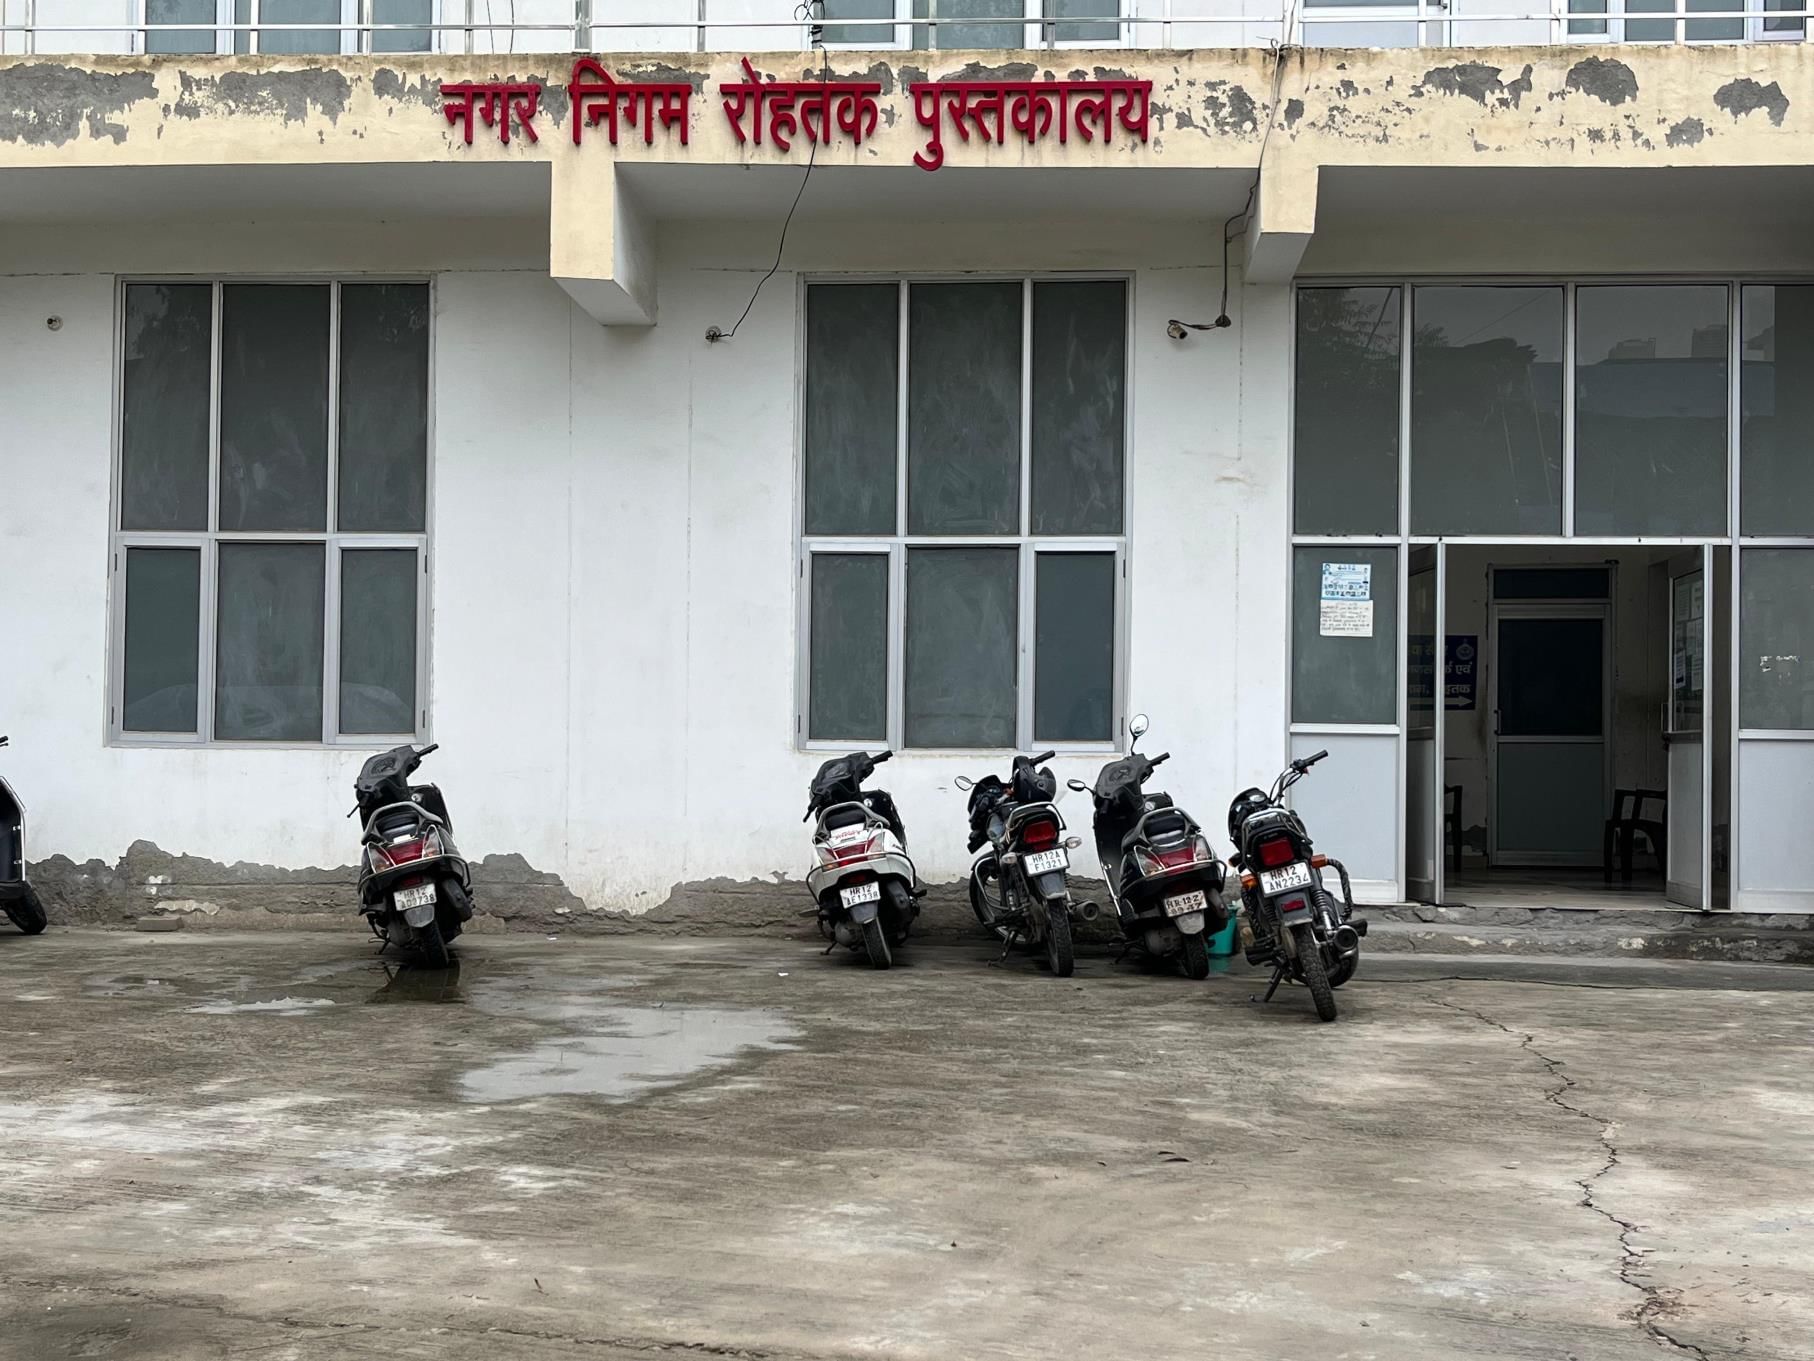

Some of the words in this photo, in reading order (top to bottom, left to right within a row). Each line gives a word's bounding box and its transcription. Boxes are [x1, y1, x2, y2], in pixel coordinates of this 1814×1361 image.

[440, 83, 541, 143] नगर
[568, 57, 692, 144] निगम
[720, 57, 881, 149] रोहतक
[909, 81, 1152, 170] पुस्तकालय
[1032, 850, 1061, 863] HR12A
[1270, 865, 1297, 880] HR12
[403, 886, 427, 898] HR12
[850, 884, 872, 896] HR12
